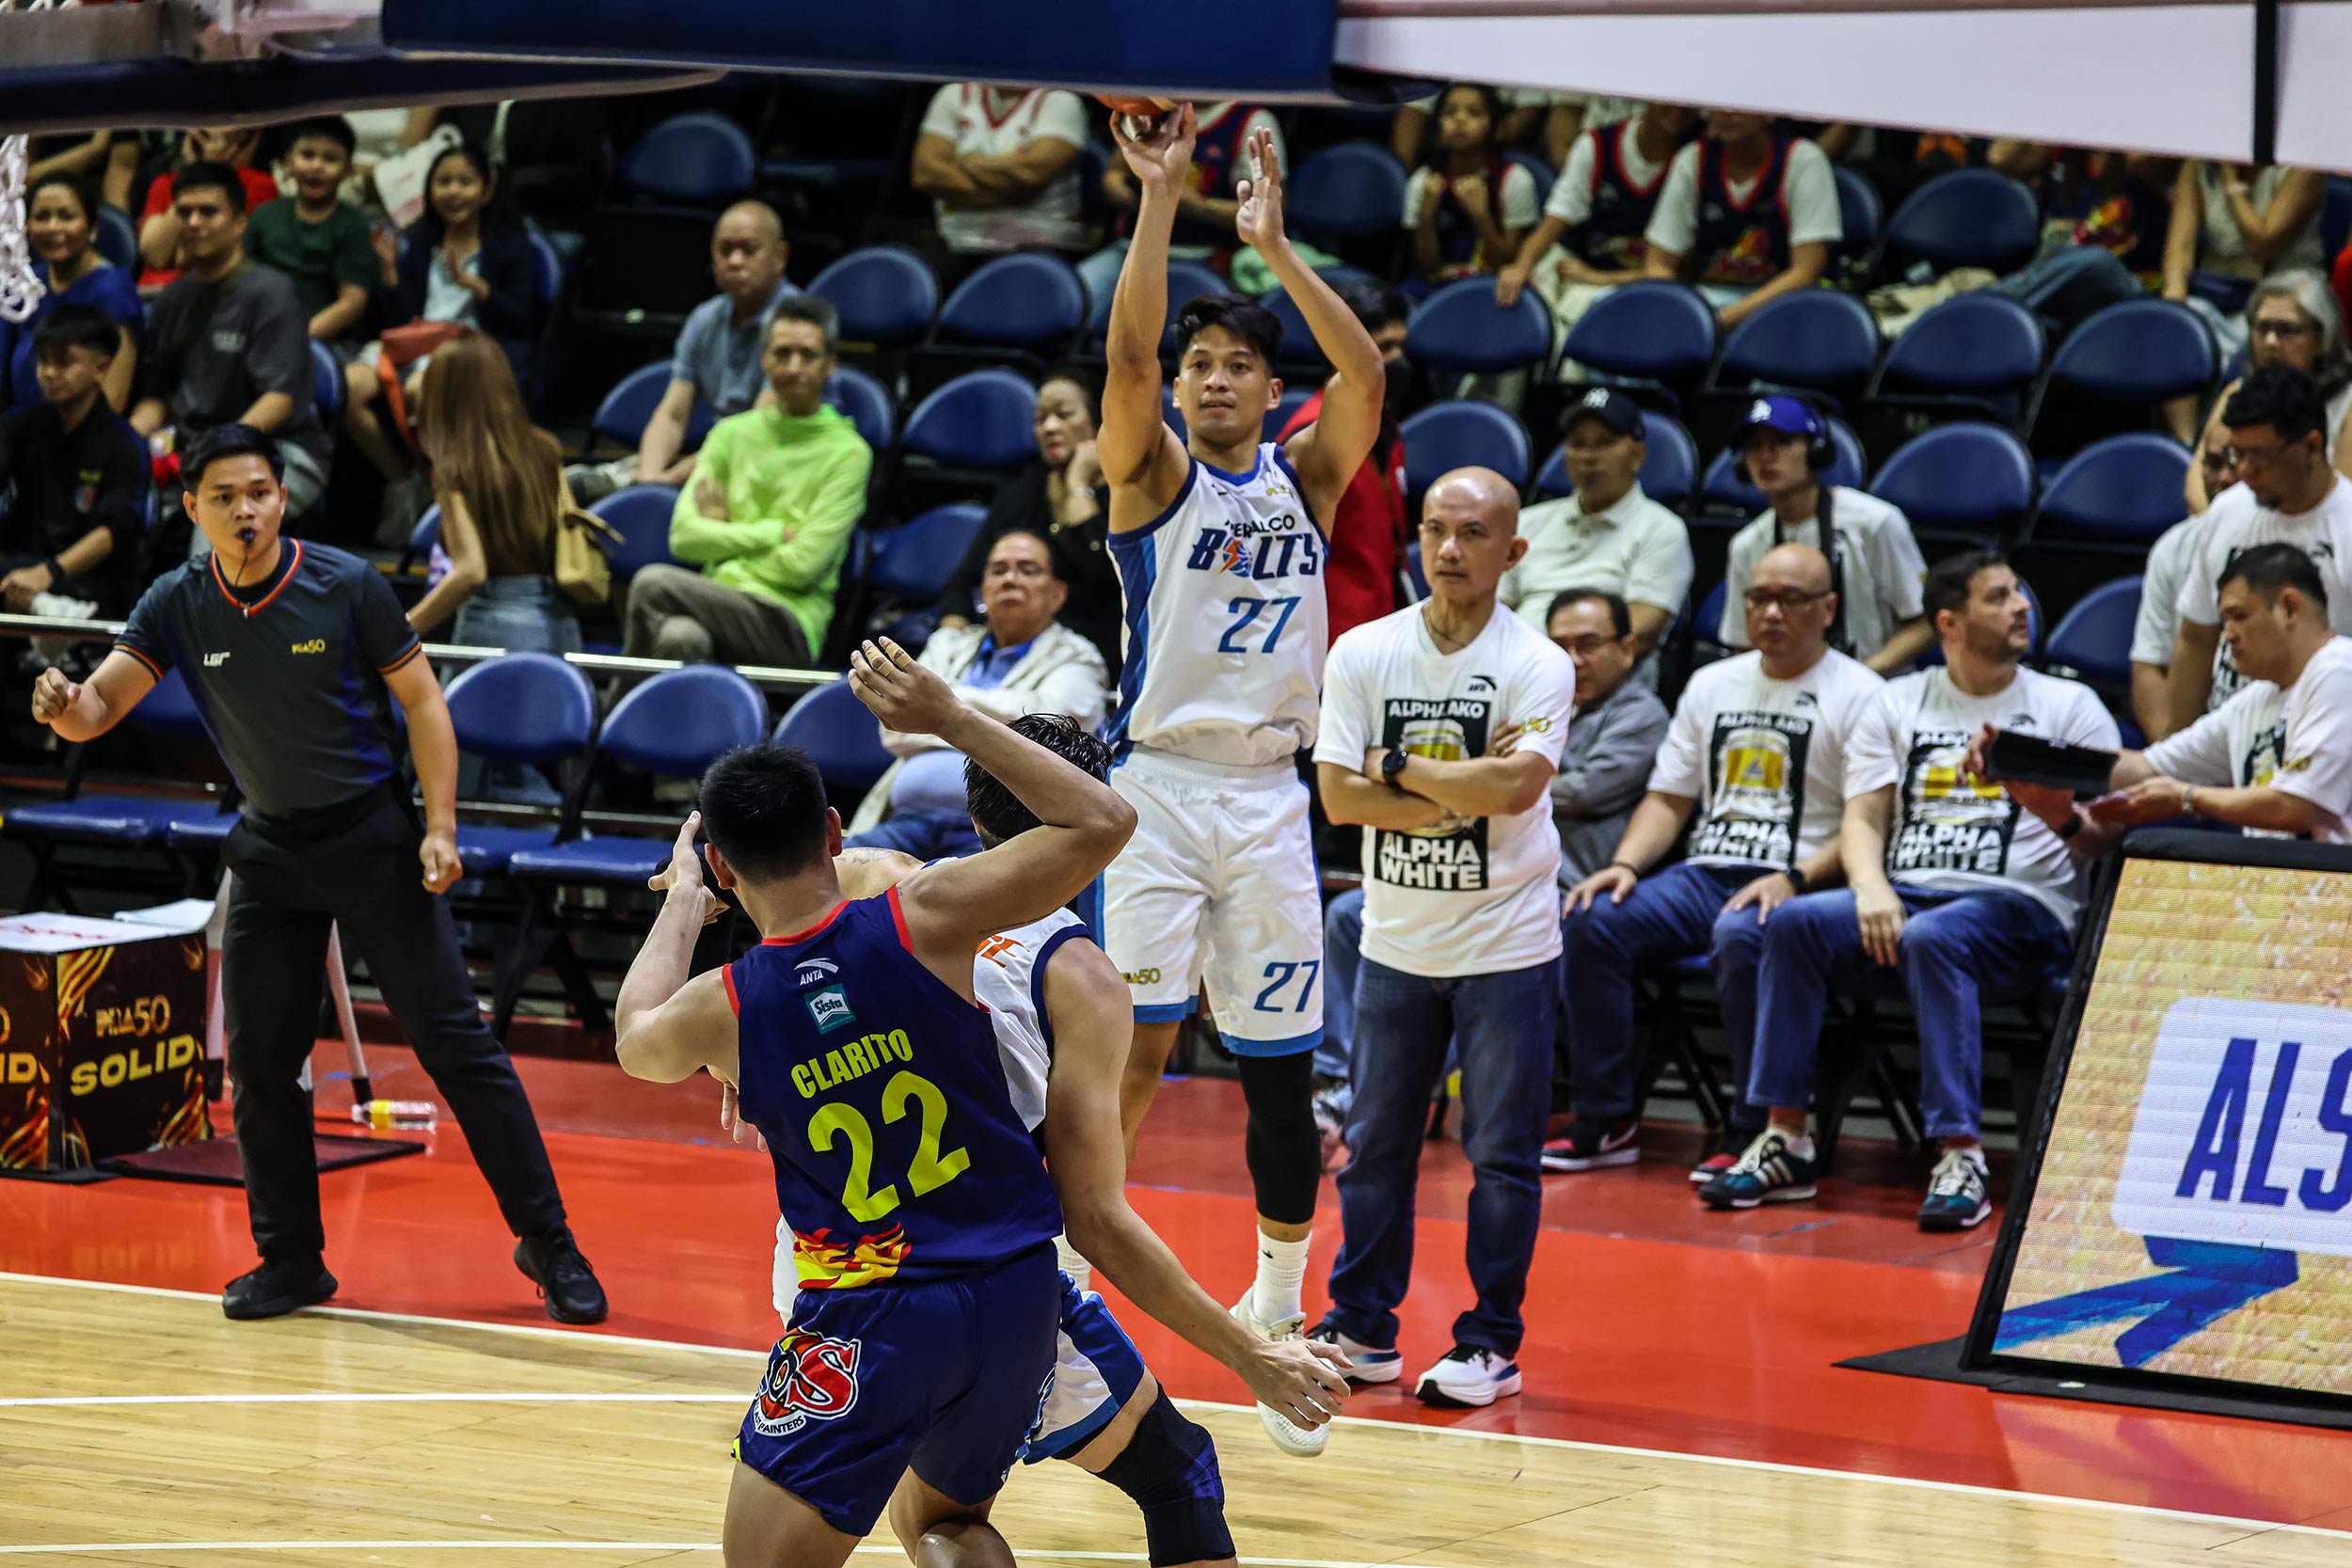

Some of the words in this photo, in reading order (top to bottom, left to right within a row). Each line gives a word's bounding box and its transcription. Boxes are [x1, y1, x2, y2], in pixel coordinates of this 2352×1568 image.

[1217, 596, 1302, 654] 27
[1447, 700, 1486, 719] AKO
[1379, 834, 1482, 864] ALPHA
[1900, 823, 2002, 850] ALPHA
[1379, 855, 1482, 890] WHITE
[1896, 845, 2002, 873] WHITE
[800, 969, 823, 986] ANTA
[1254, 959, 1321, 1013] 27
[814, 999, 843, 1015] Sista
[71, 1034, 196, 1096] SOLID
[790, 1028, 914, 1099] CLARITO
[807, 1069, 971, 1223] 22
[756, 1415, 804, 1433] PAINTERS
